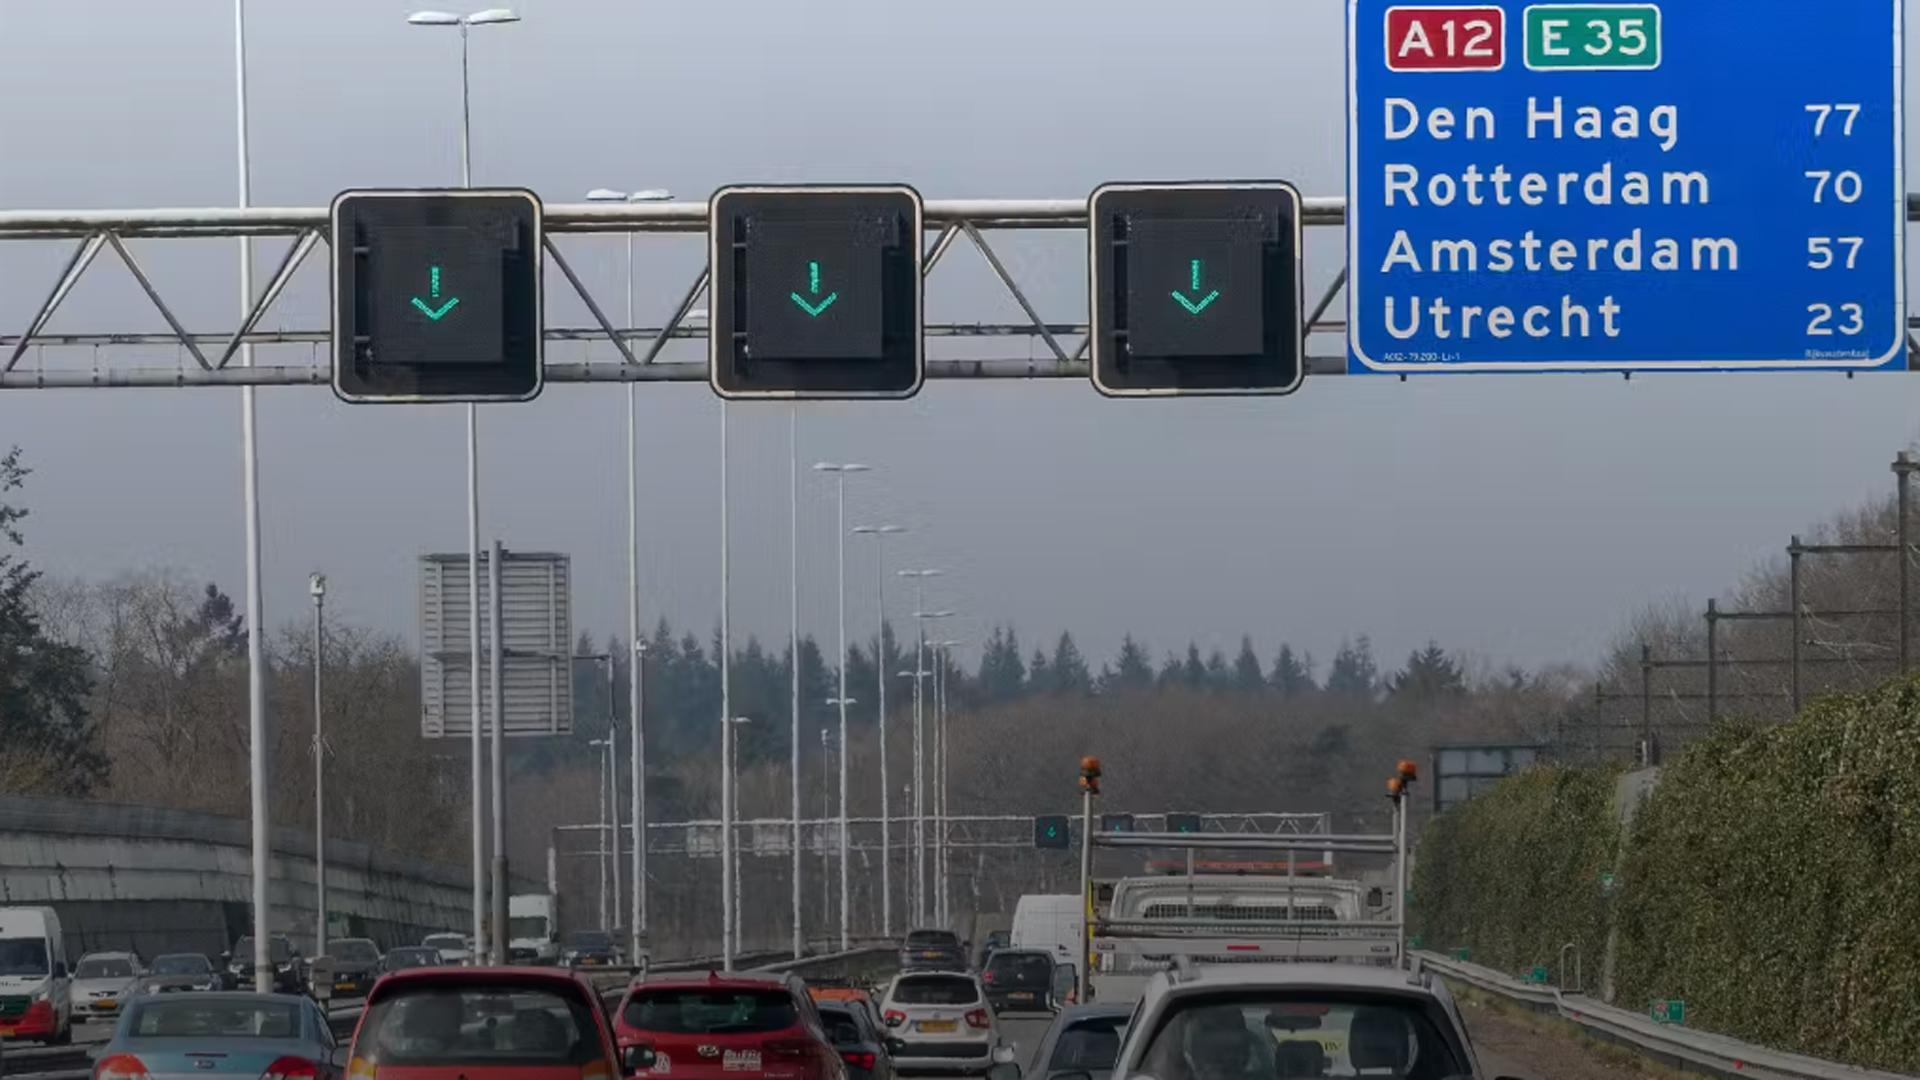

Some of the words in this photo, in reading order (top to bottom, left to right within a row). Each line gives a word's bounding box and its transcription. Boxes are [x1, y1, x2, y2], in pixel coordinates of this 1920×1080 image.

[1398, 19, 1493, 57] A12
[1542, 19, 1570, 56] E
[1584, 19, 1647, 56] 35
[1384, 97, 1495, 140] Den
[1527, 96, 1678, 152] Haag
[1805, 103, 1861, 136] 77
[1384, 162, 1709, 207] Rotterdam
[1805, 170, 1862, 203] 70
[1380, 228, 1738, 273] Amsterdam
[1808, 236, 1864, 269] 57
[1384, 294, 1621, 339] Utrecht
[1806, 303, 1863, 336] 23
